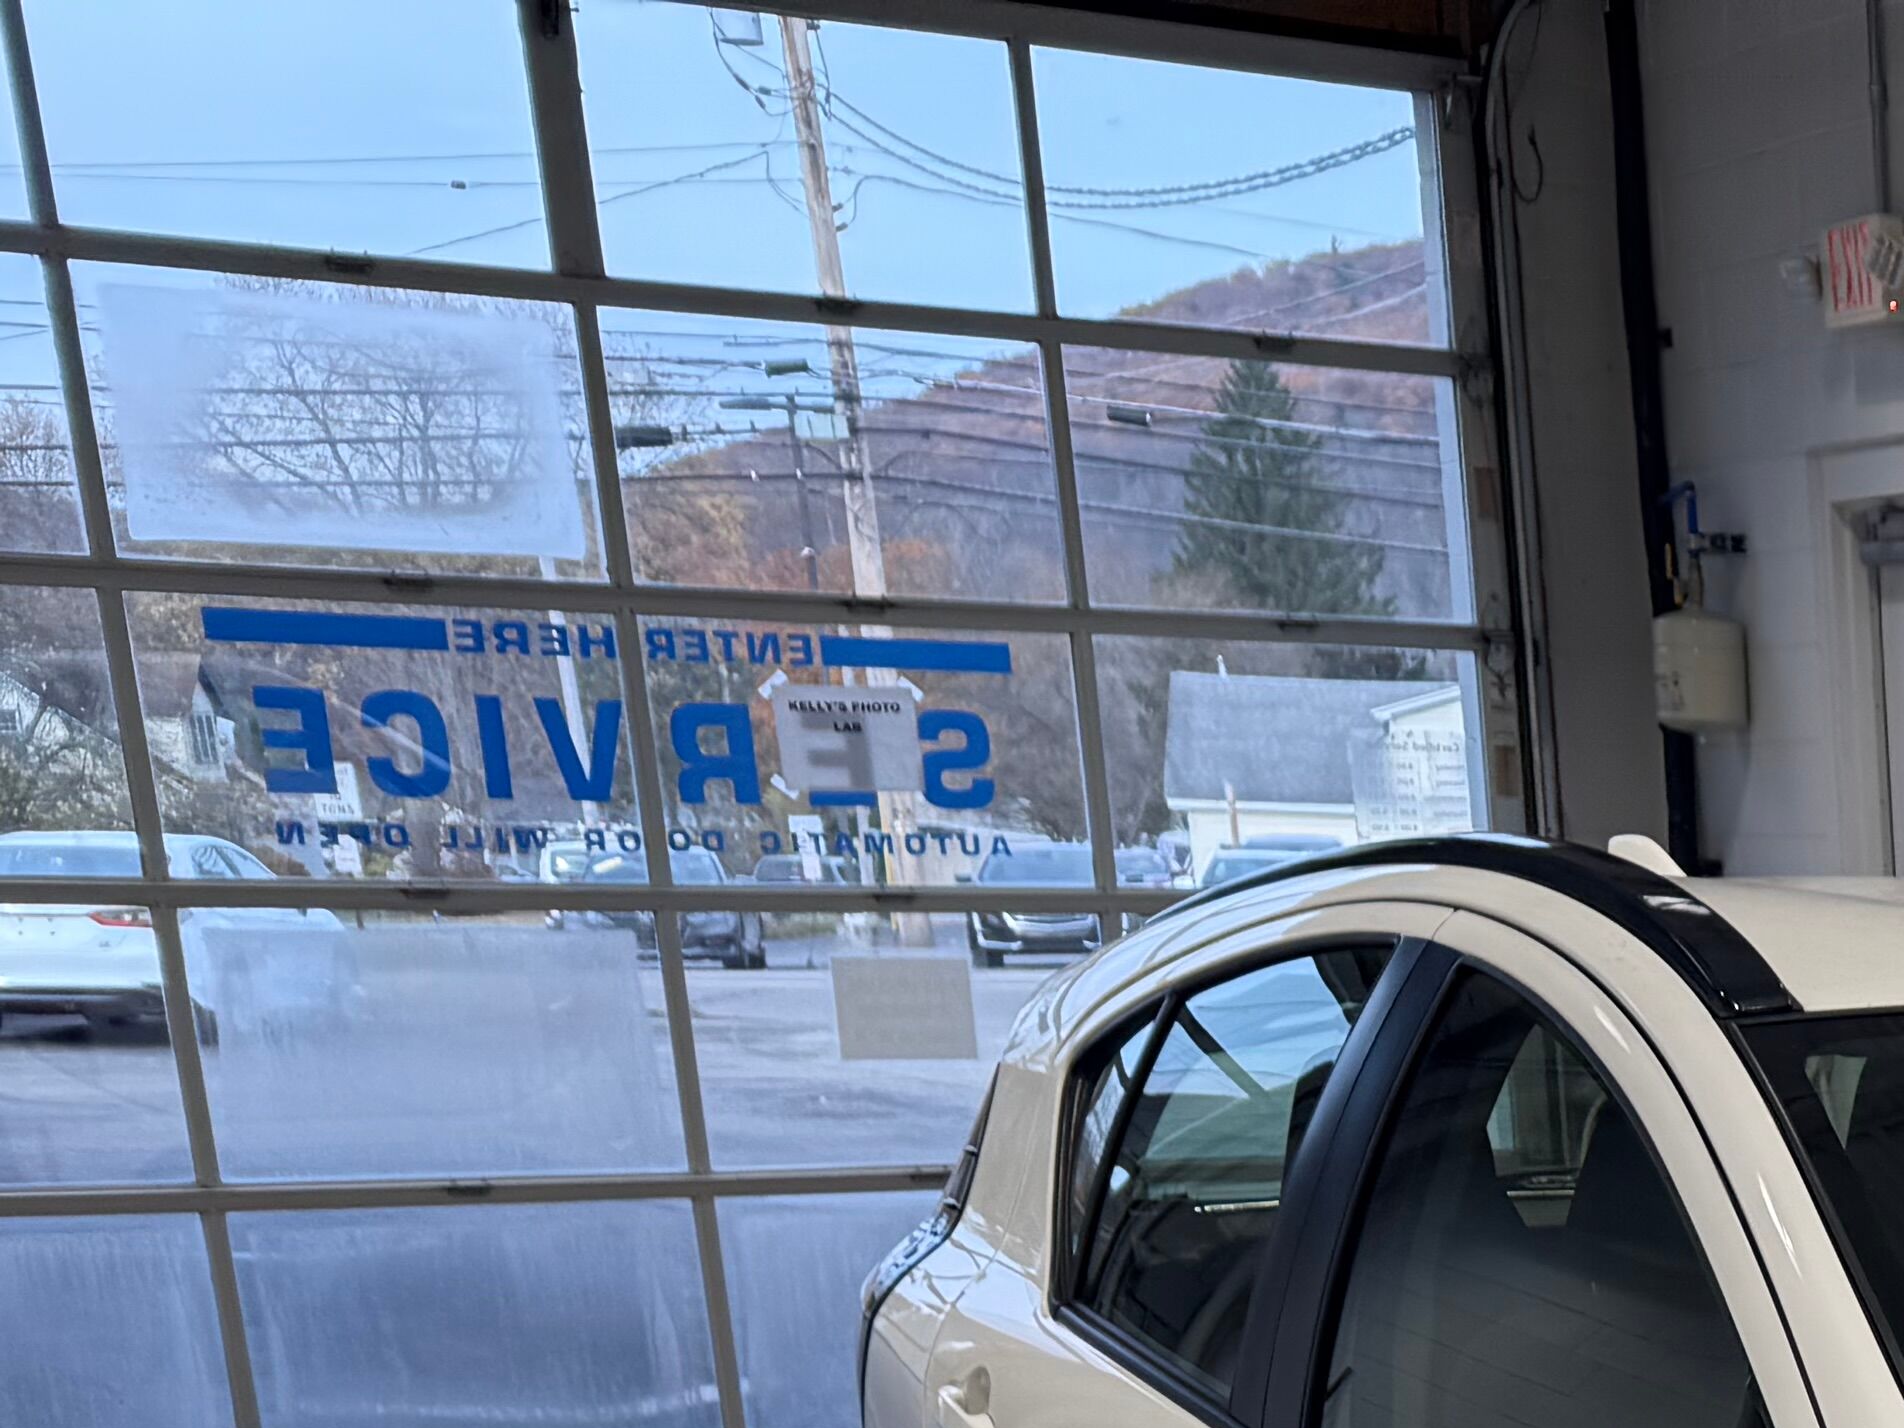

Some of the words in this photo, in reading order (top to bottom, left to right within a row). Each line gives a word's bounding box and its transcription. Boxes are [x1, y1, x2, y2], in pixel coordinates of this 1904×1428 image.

[788, 699, 848, 713] KELLY'S
[851, 701, 901, 713] PHOTO
[834, 721, 862, 733] LAB
